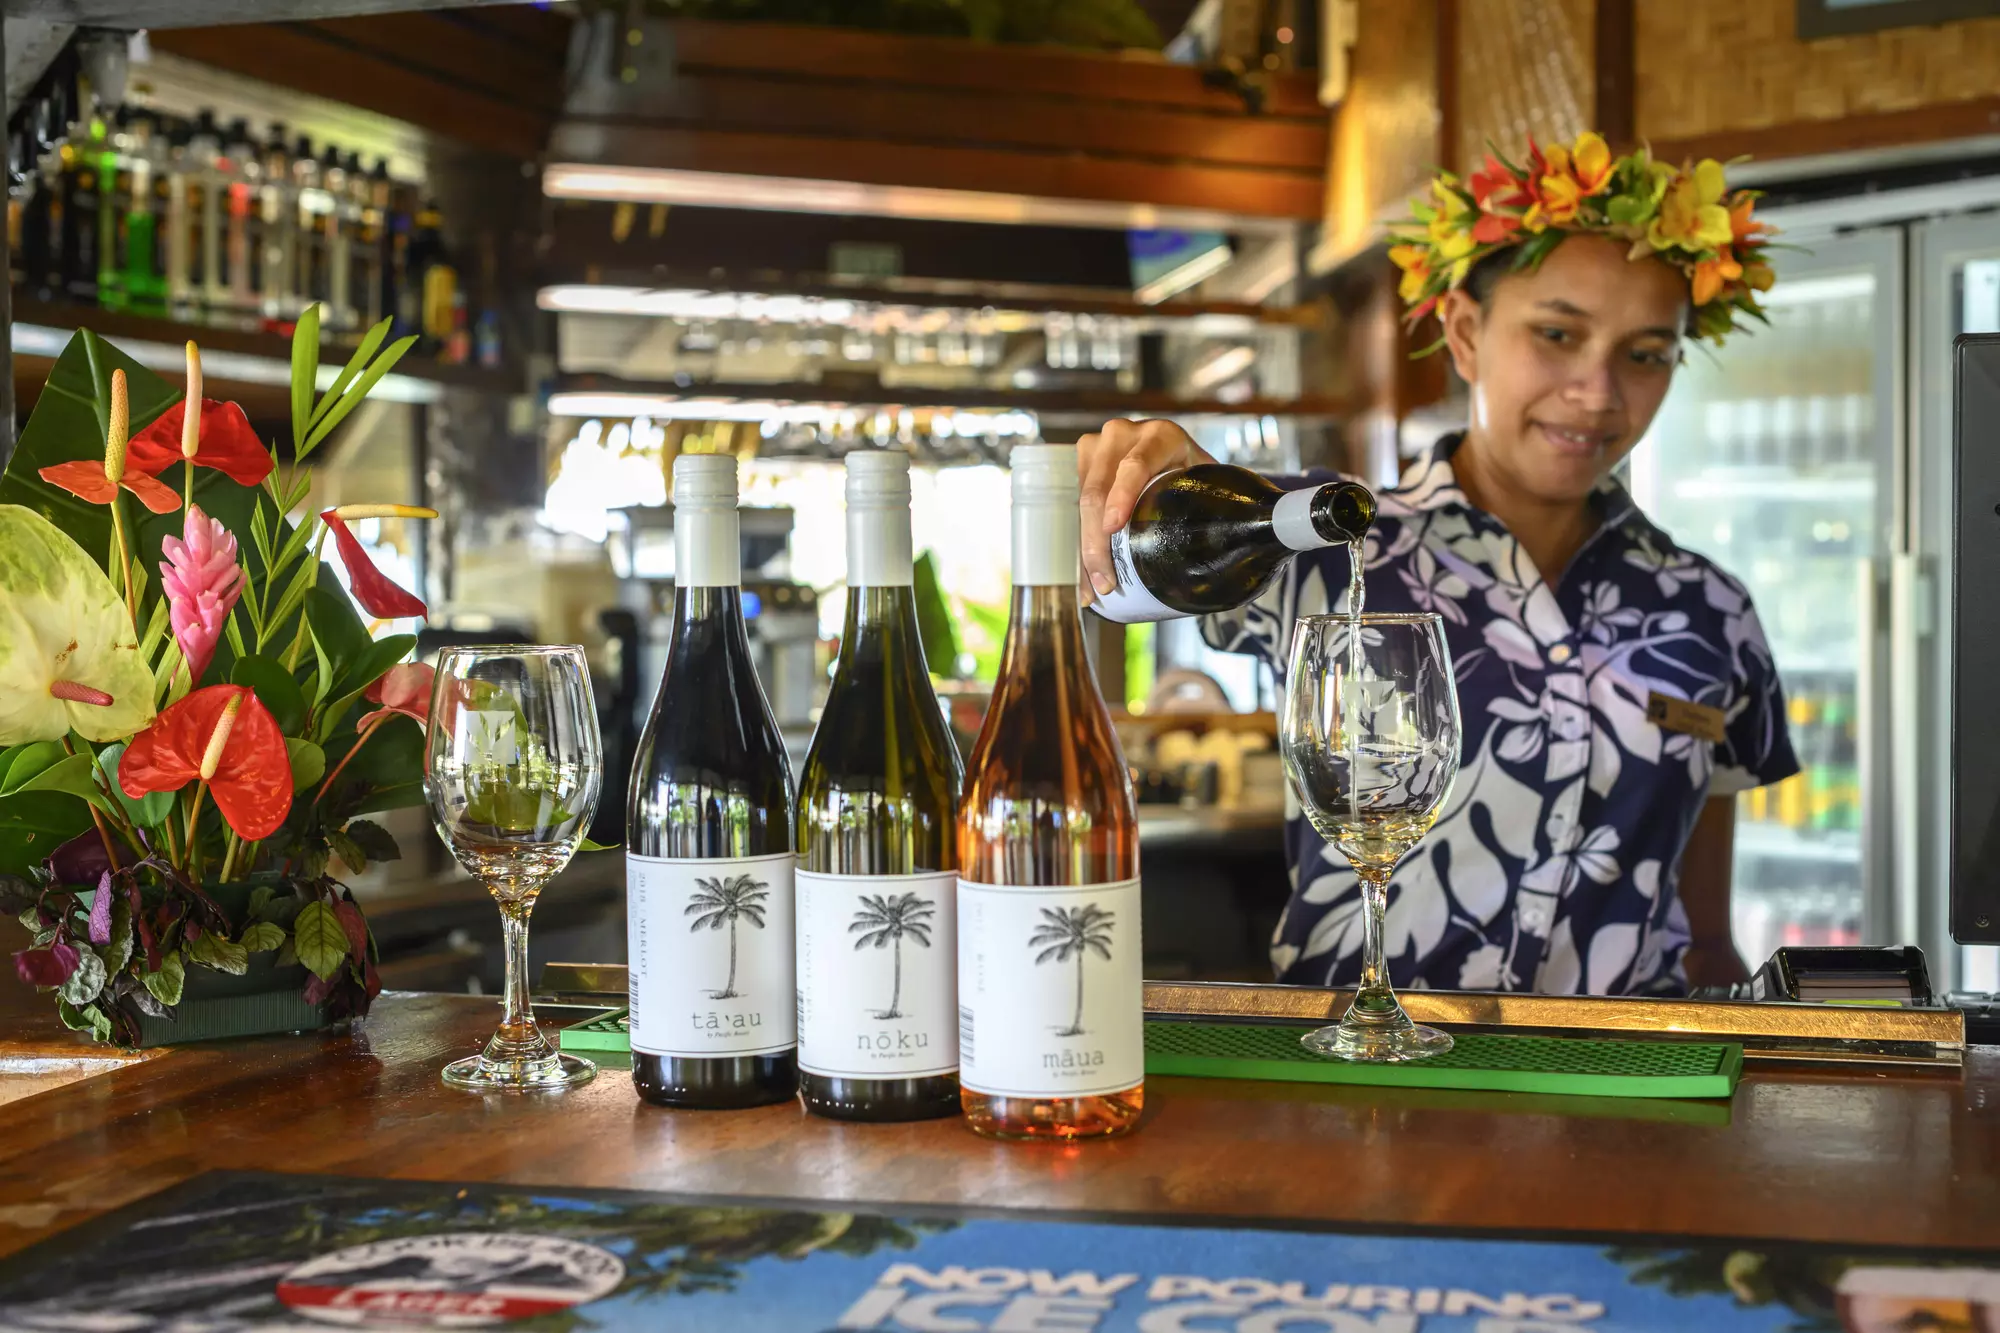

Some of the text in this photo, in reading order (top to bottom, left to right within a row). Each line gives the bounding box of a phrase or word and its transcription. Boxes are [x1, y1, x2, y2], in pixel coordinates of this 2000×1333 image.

[640, 917, 648, 977] MERLOT
[857, 1029, 928, 1050] nōku
[1043, 1049, 1104, 1068] māua
[838, 1286, 1114, 1333] ICE
[880, 1263, 1605, 1321] NOW POURING
